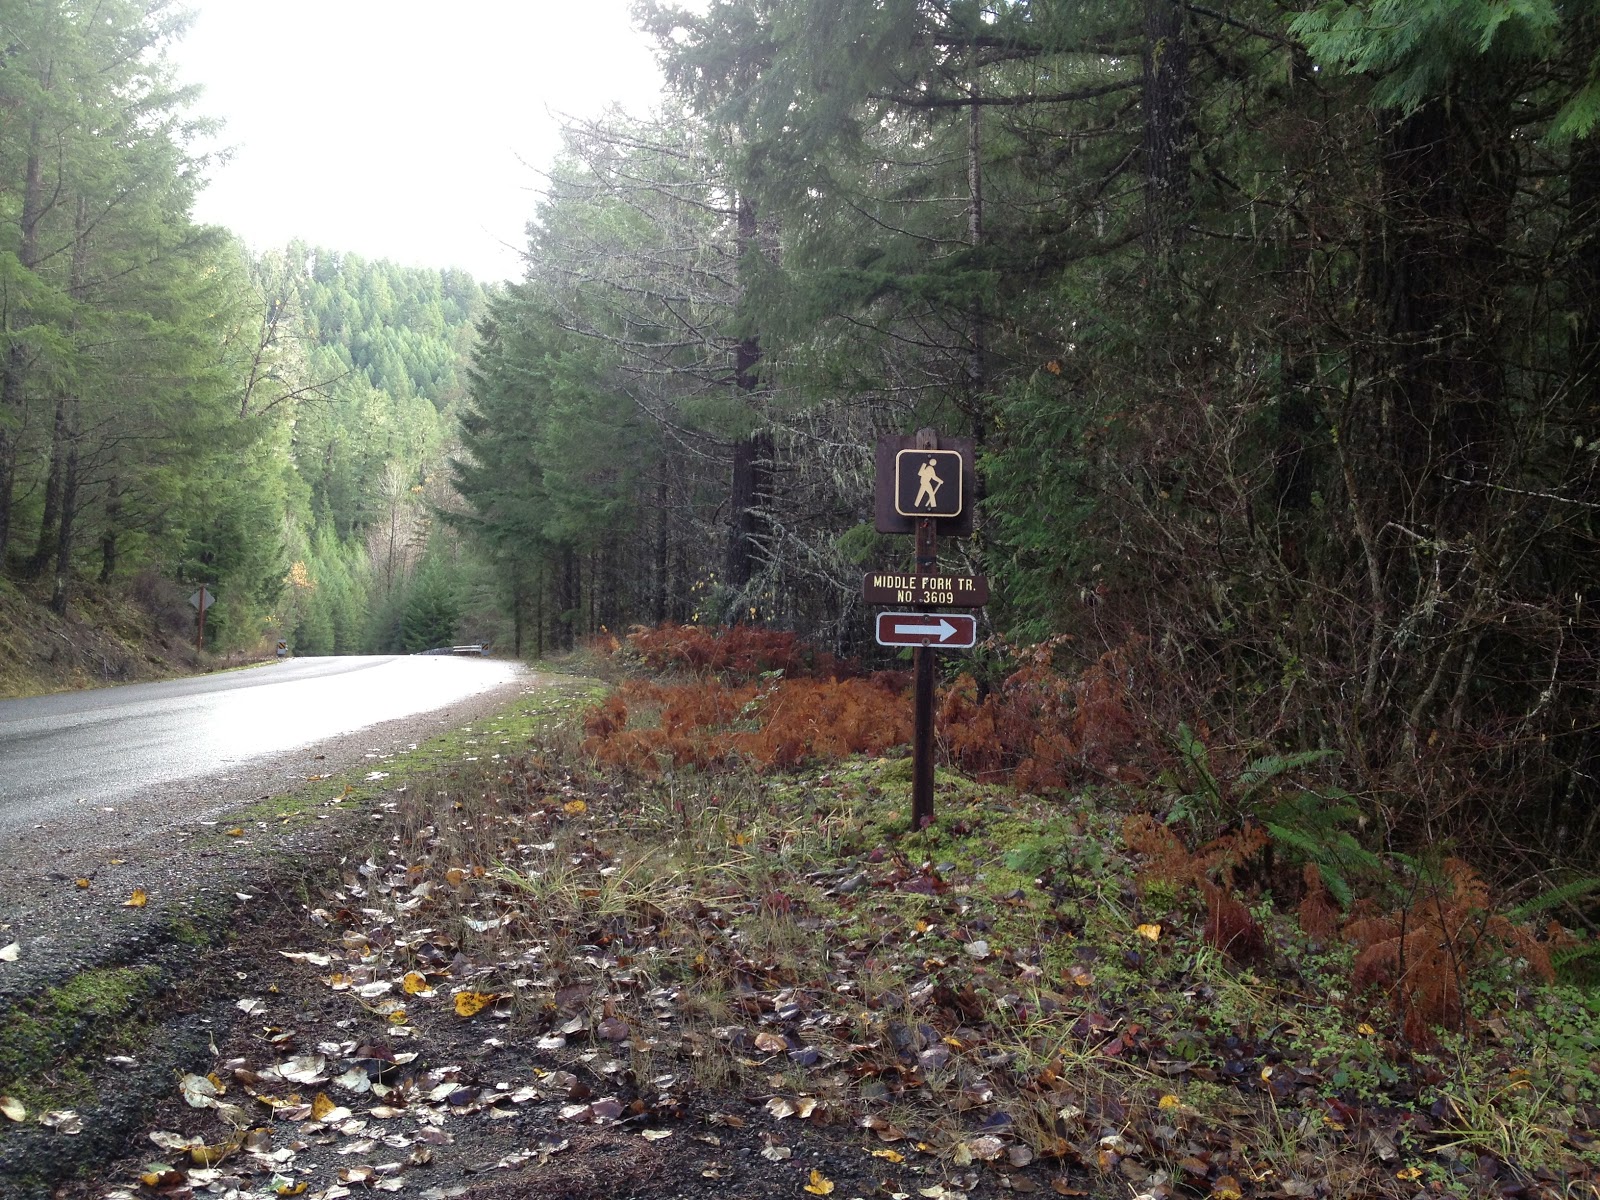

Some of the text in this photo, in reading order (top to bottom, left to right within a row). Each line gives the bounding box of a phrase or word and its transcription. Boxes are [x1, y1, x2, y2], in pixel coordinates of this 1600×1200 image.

[873, 575, 976, 591] MIDDLE FORK TR.
[923, 591, 954, 604] 3609
